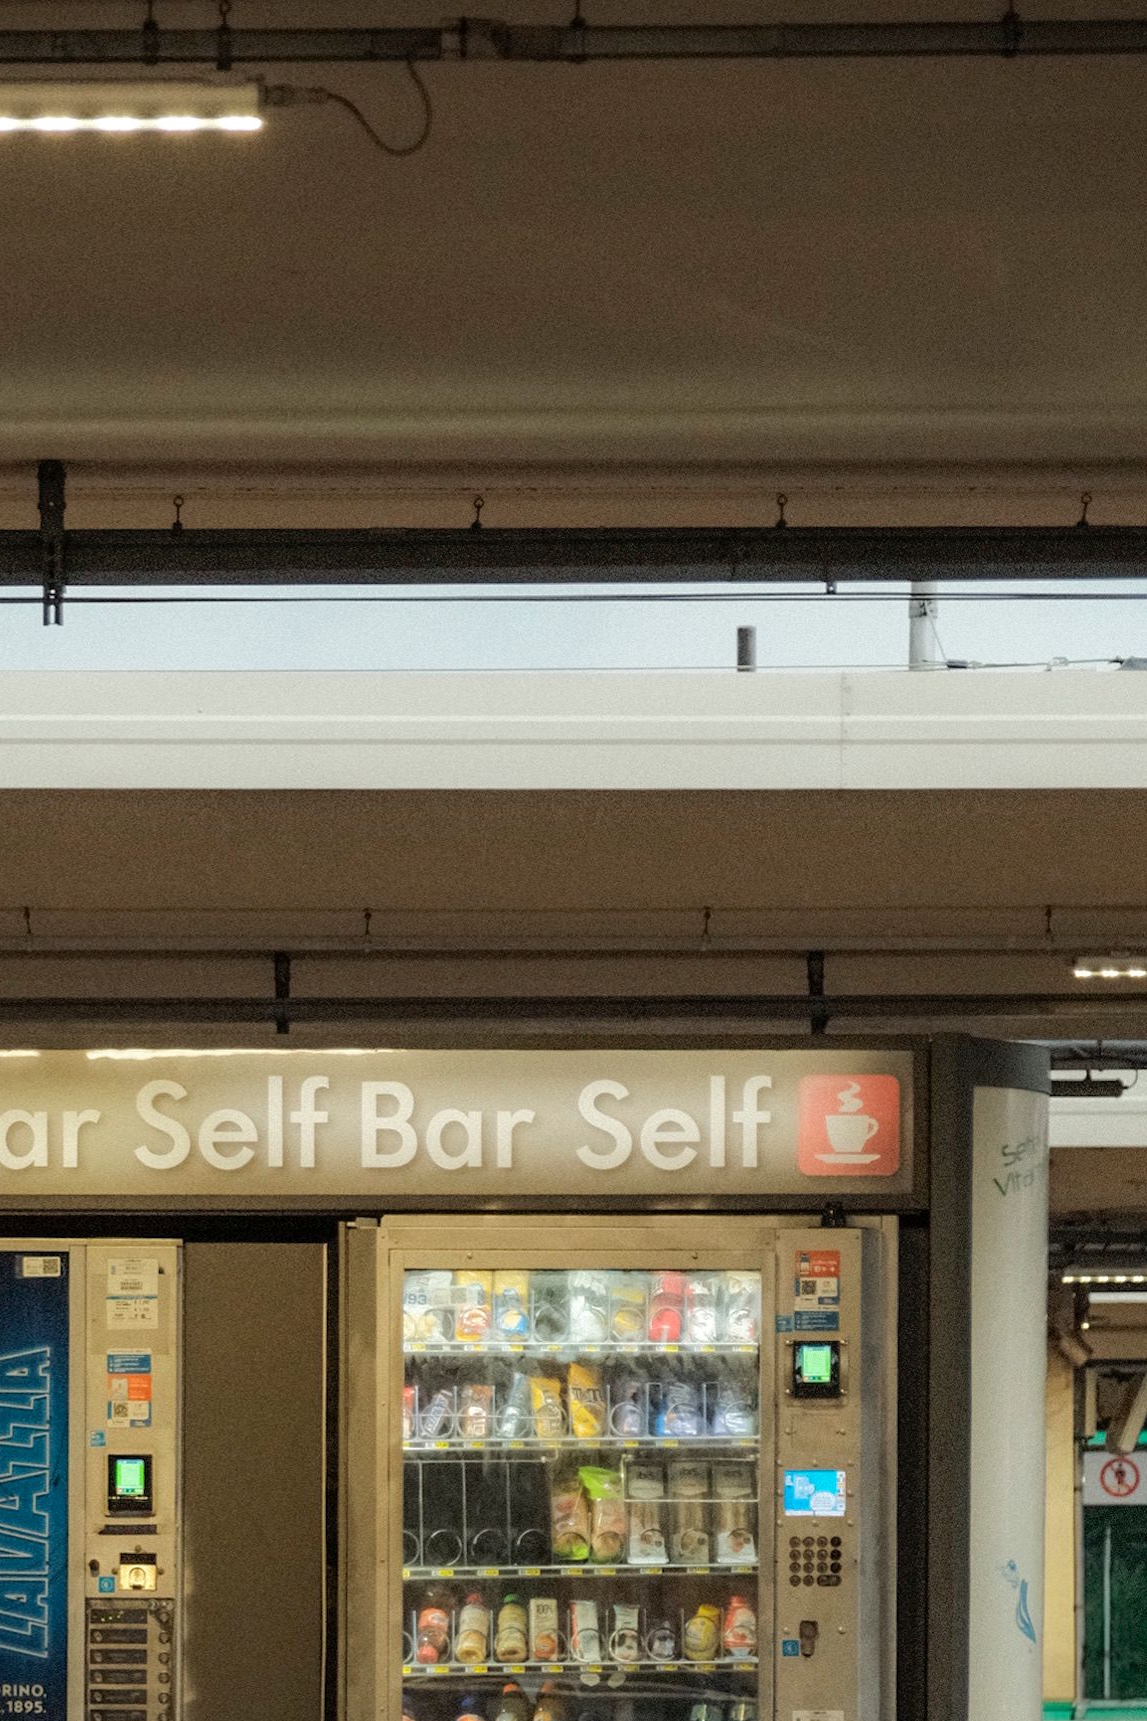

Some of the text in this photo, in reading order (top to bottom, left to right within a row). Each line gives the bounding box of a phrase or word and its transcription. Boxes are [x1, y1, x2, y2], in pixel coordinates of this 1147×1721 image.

[134, 1075, 330, 1171] Self
[361, 1081, 535, 1171] Bar
[575, 1075, 773, 1171] Self
[6, 1700, 47, 1714] 1895.
